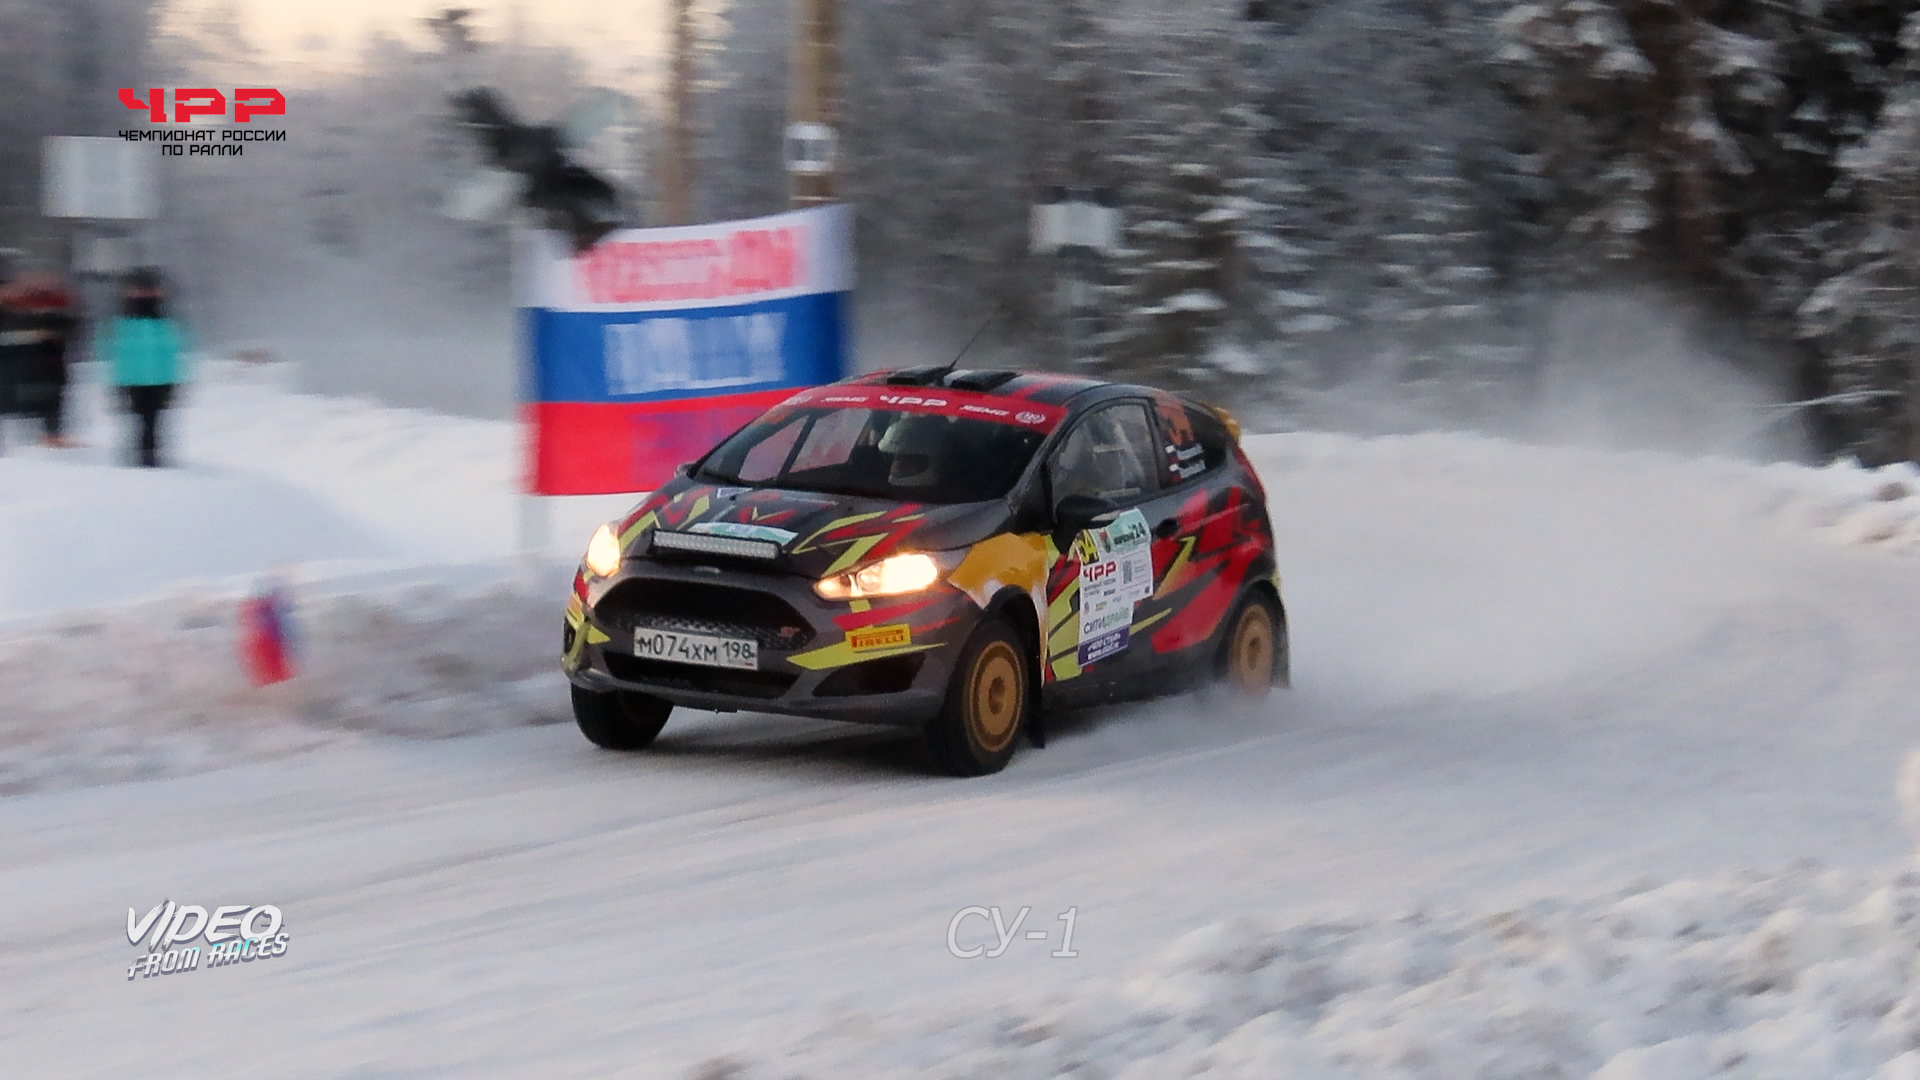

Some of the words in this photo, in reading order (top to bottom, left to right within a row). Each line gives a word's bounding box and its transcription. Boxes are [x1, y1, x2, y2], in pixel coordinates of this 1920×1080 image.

[880, 395, 948, 407] ЧРР
[1083, 561, 1117, 582] ЧРР
[636, 634, 718, 661] М074ХМ
[721, 641, 752, 659] 198
[851, 629, 904, 648] PIRELLI
